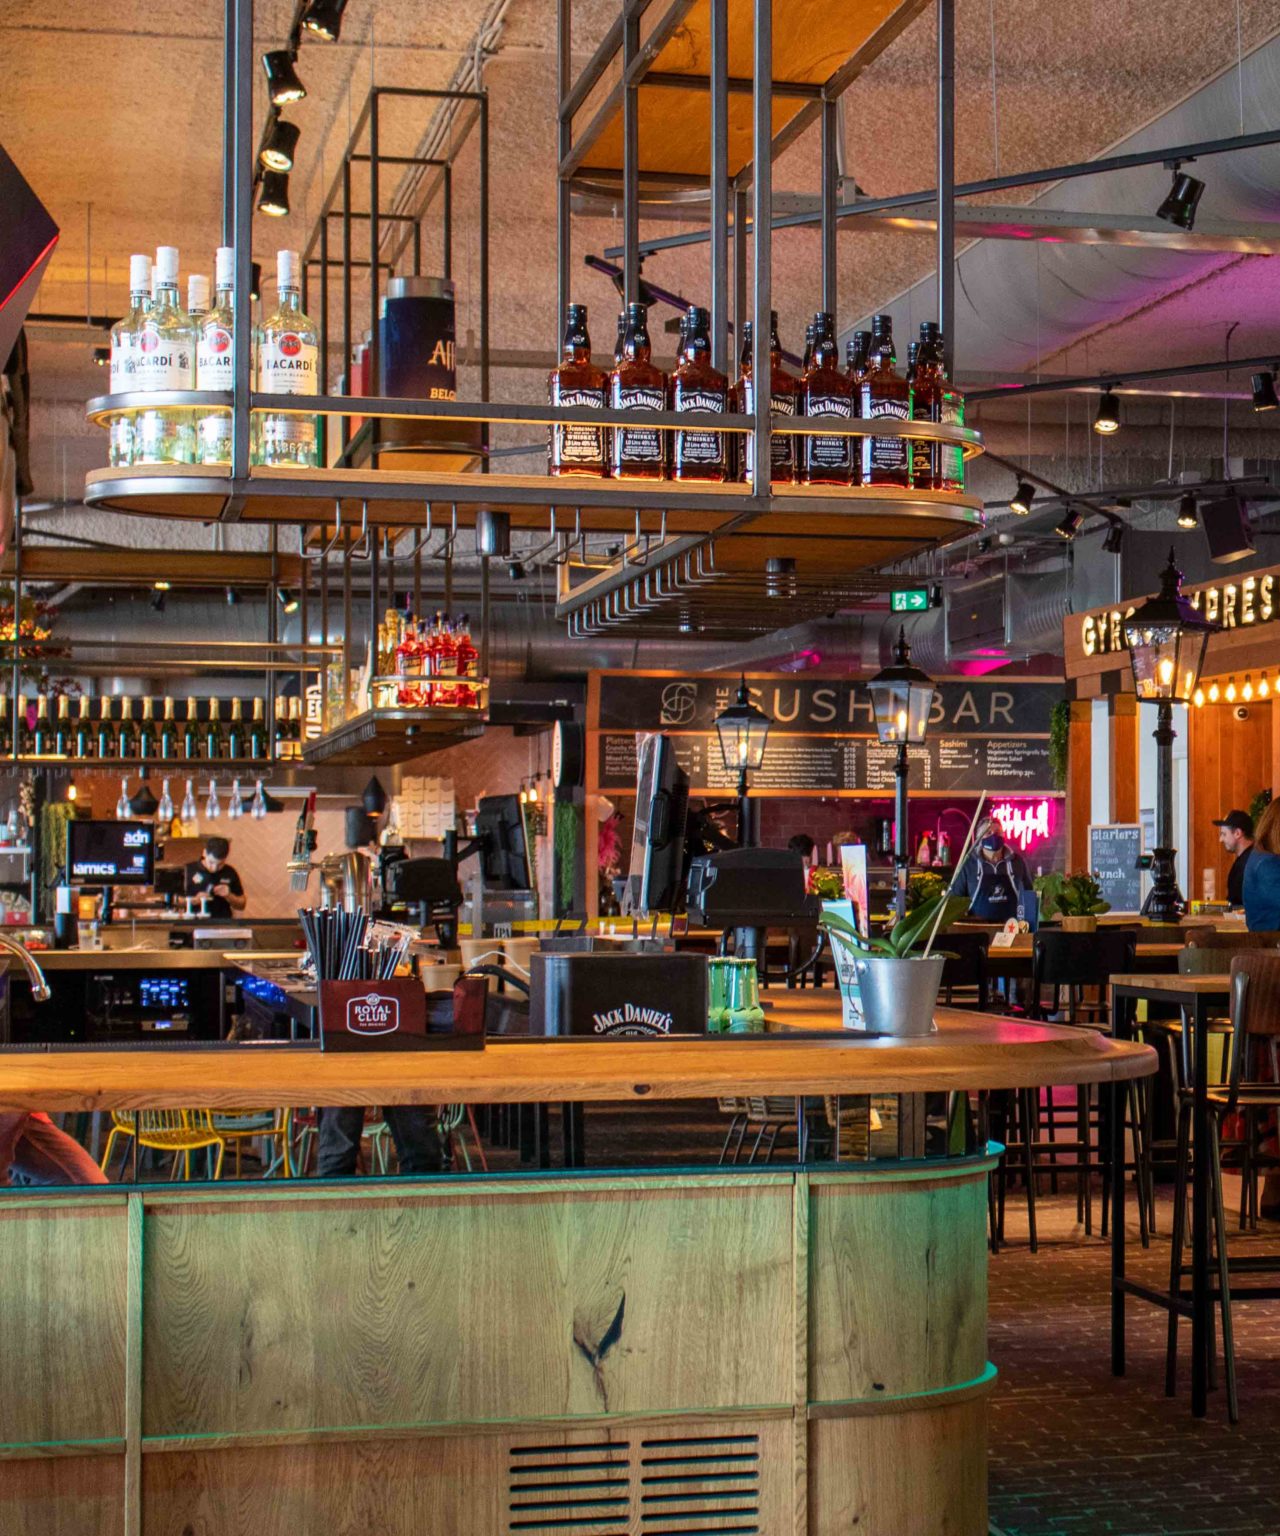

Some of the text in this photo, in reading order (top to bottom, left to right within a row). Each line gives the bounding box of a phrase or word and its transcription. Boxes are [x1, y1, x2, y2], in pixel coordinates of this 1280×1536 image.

[940, 740, 968, 748] Sashimi
[124, 829, 150, 844] adn
[355, 1005, 391, 1014] ROYAL
[358, 1014, 387, 1022] CLUB
[593, 1003, 673, 1033] JACK DANIEL'S
